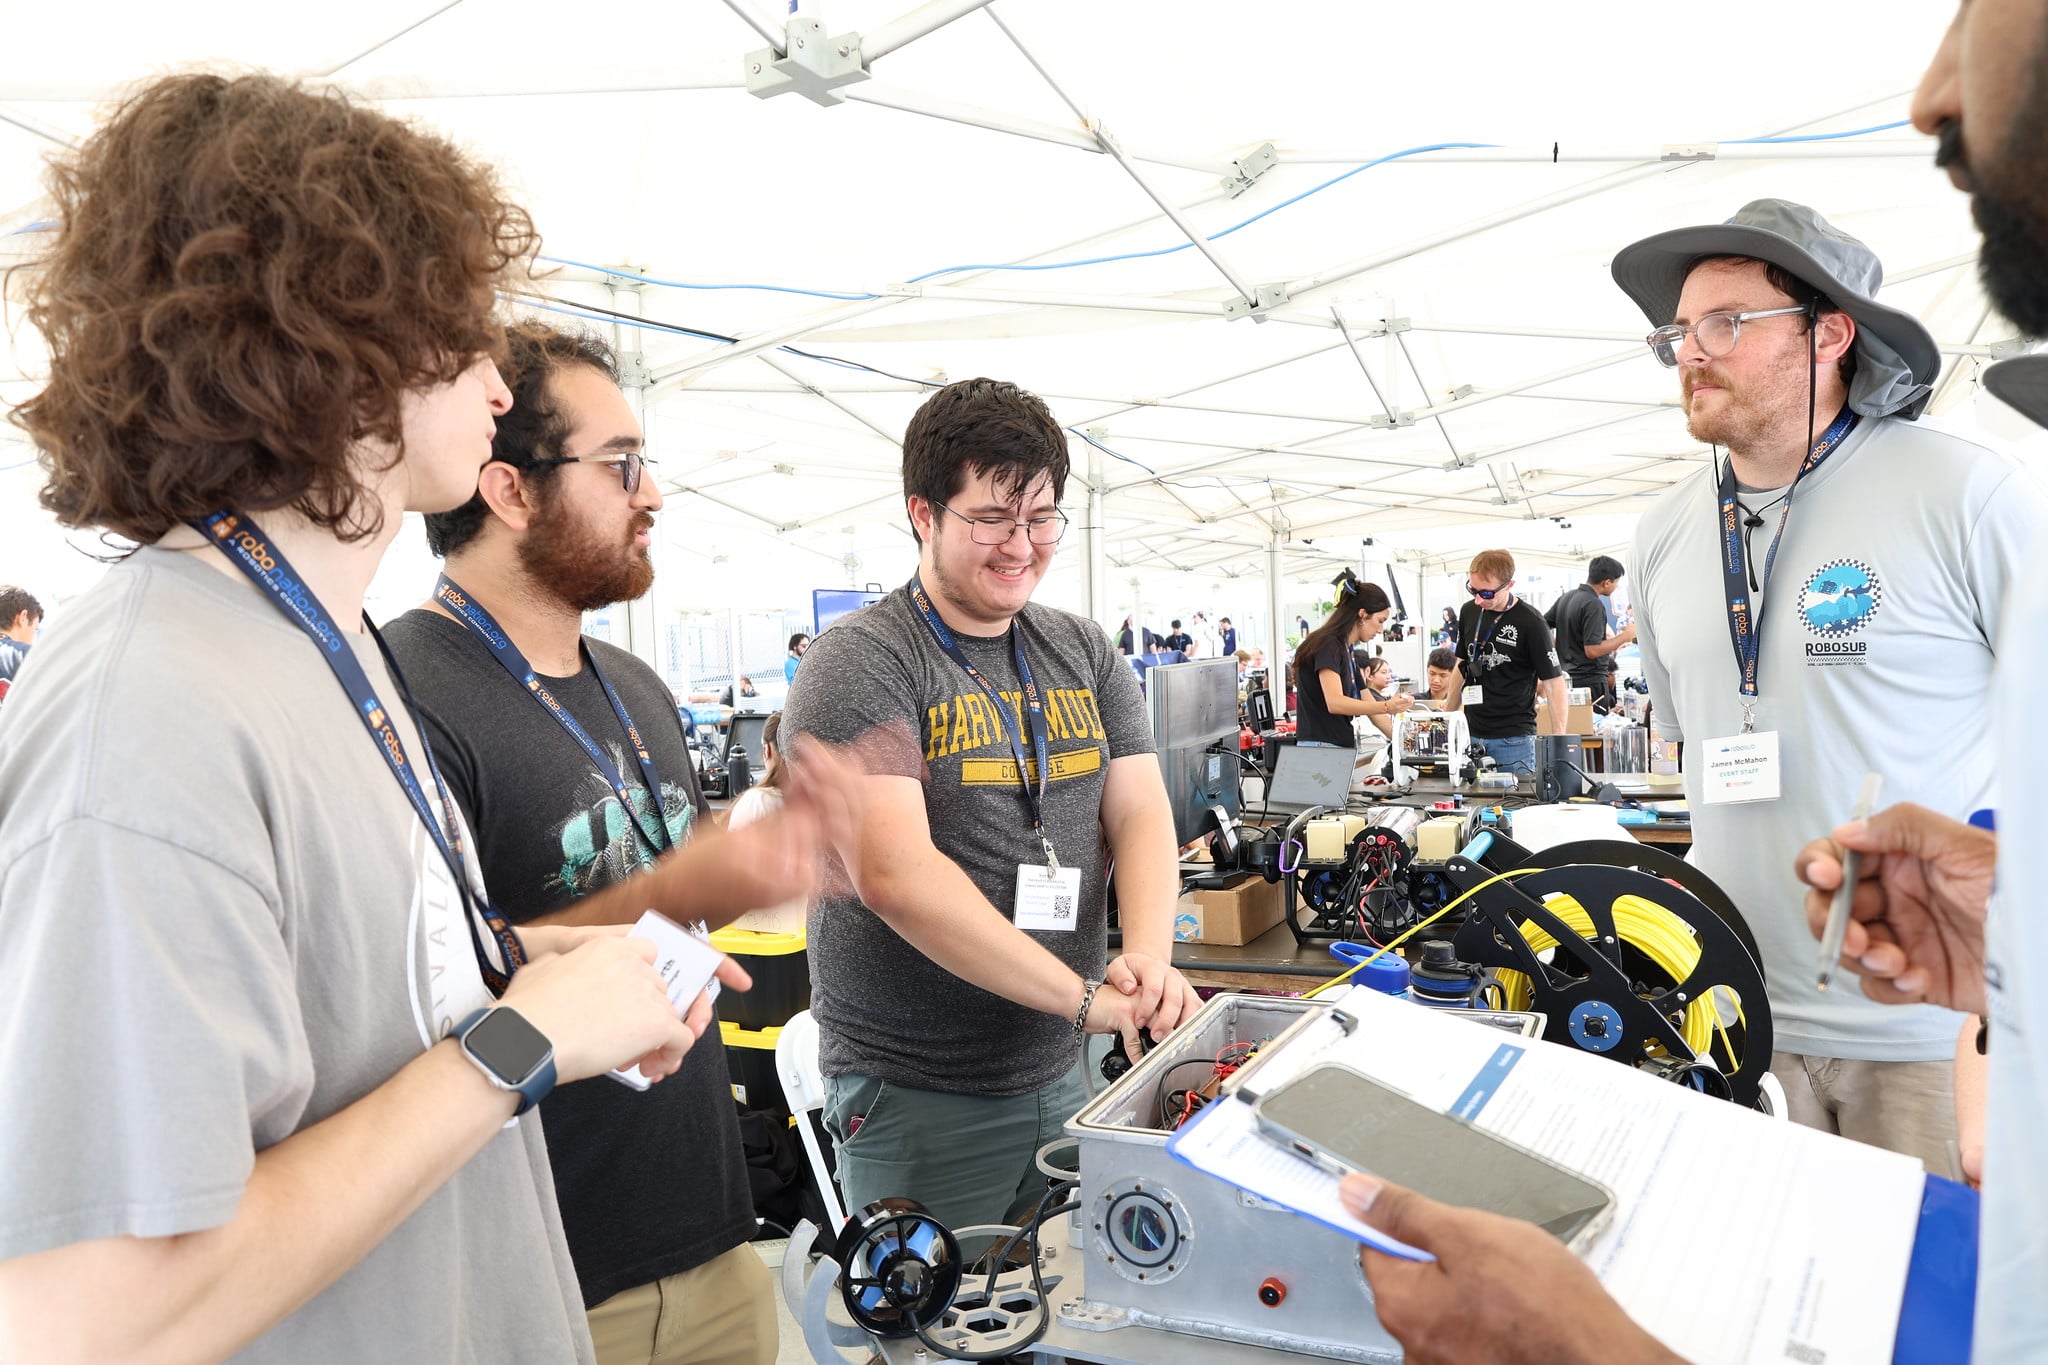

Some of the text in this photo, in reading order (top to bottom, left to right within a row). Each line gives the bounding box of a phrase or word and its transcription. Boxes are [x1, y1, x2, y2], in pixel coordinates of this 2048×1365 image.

[233, 530, 342, 653] robonation.org
[236, 546, 280, 592] ROBOTICS
[279, 591, 329, 643] COMMUNITY
[445, 589, 507, 650] robonation.org
[467, 616, 497, 645] COMMUNITY
[1805, 641, 1868, 657] ROBOSUB
[539, 688, 600, 757] robonation.org
[926, 691, 1028, 761] HARVY
[1045, 687, 1107, 742] MUD
[1710, 756, 1768, 768] James McMahon
[1719, 767, 1759, 778] EVENT STAFF
